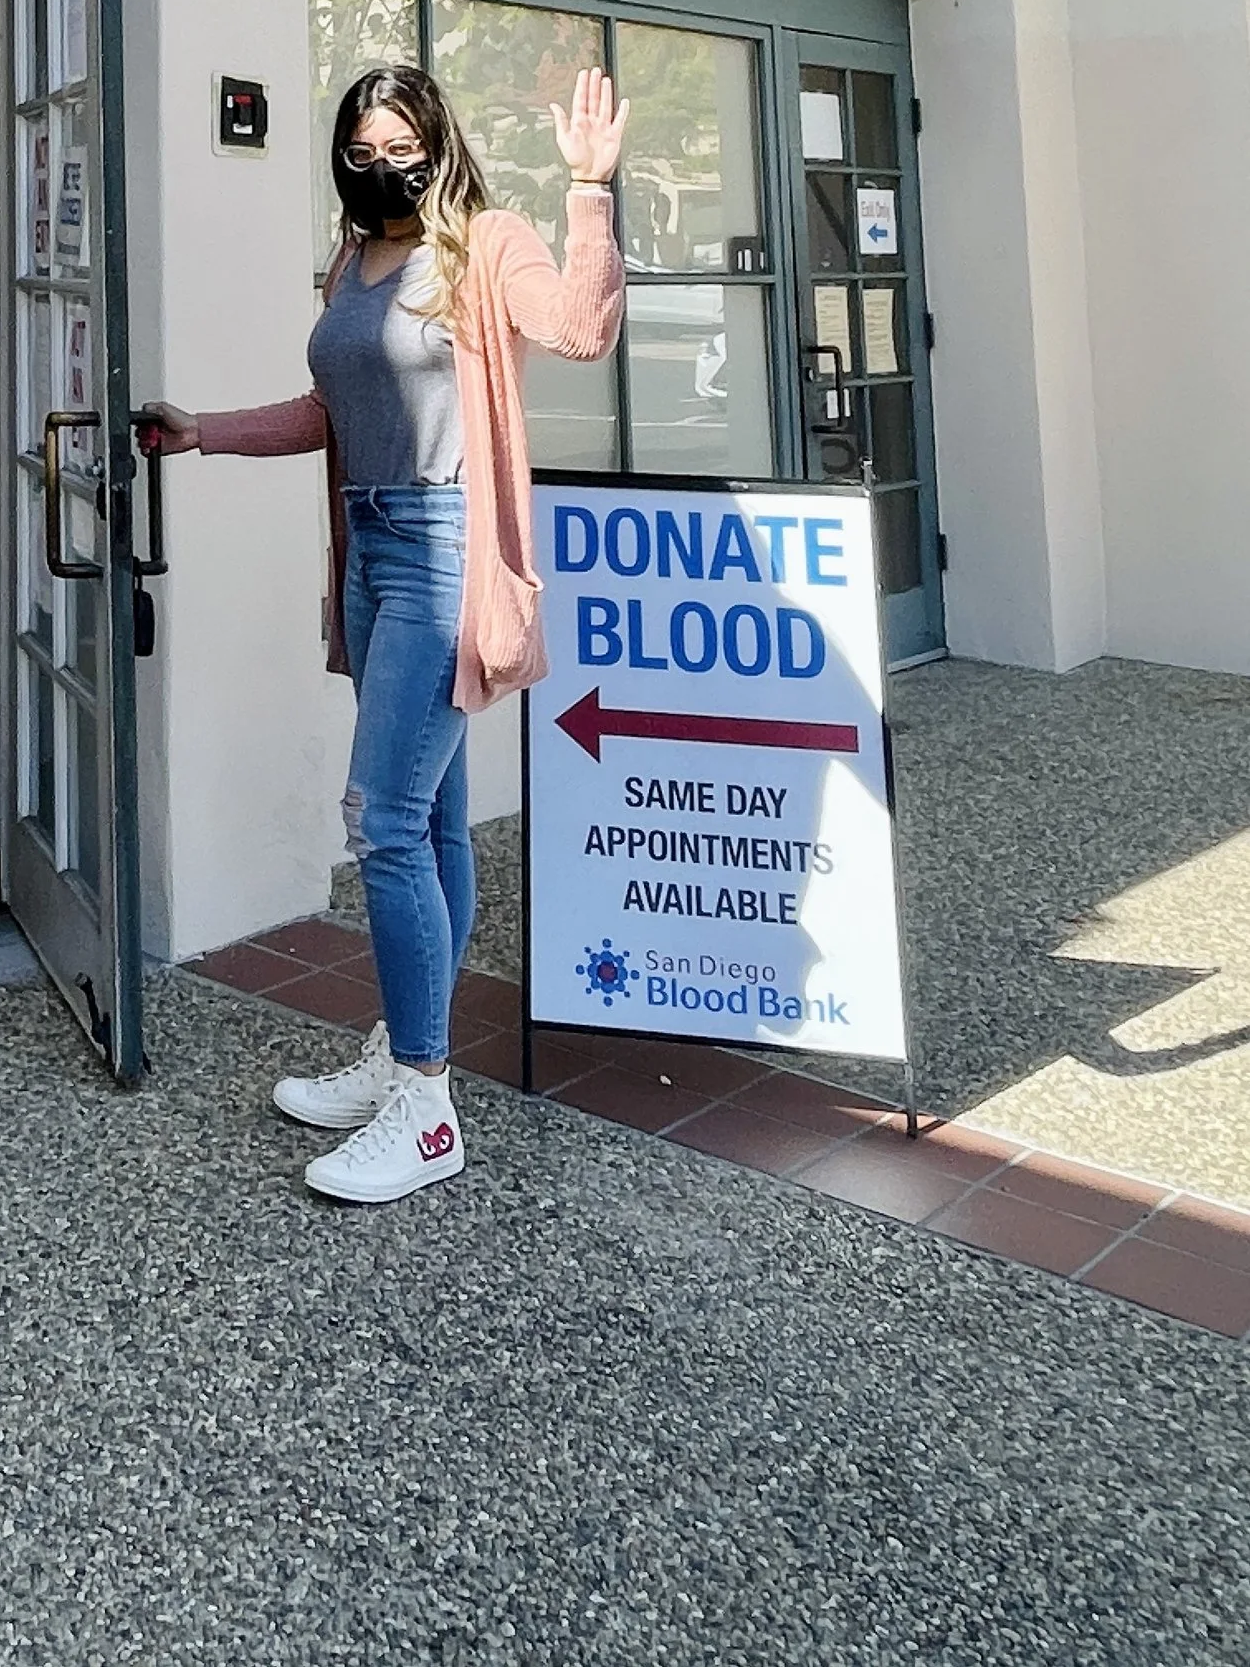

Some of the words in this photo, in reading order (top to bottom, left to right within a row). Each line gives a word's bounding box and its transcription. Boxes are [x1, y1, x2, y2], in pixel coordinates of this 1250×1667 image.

[553, 504, 848, 588] DONATE
[576, 595, 827, 679] BLOOD
[624, 776, 717, 814] SAME
[727, 782, 788, 819] DAY
[584, 824, 834, 875] APPOINTMENTS
[623, 880, 799, 926] AVAILABLE
[645, 949, 691, 974] San
[699, 955, 777, 985] Diego
[646, 976, 749, 1015] Blood
[758, 986, 851, 1026] Bank
